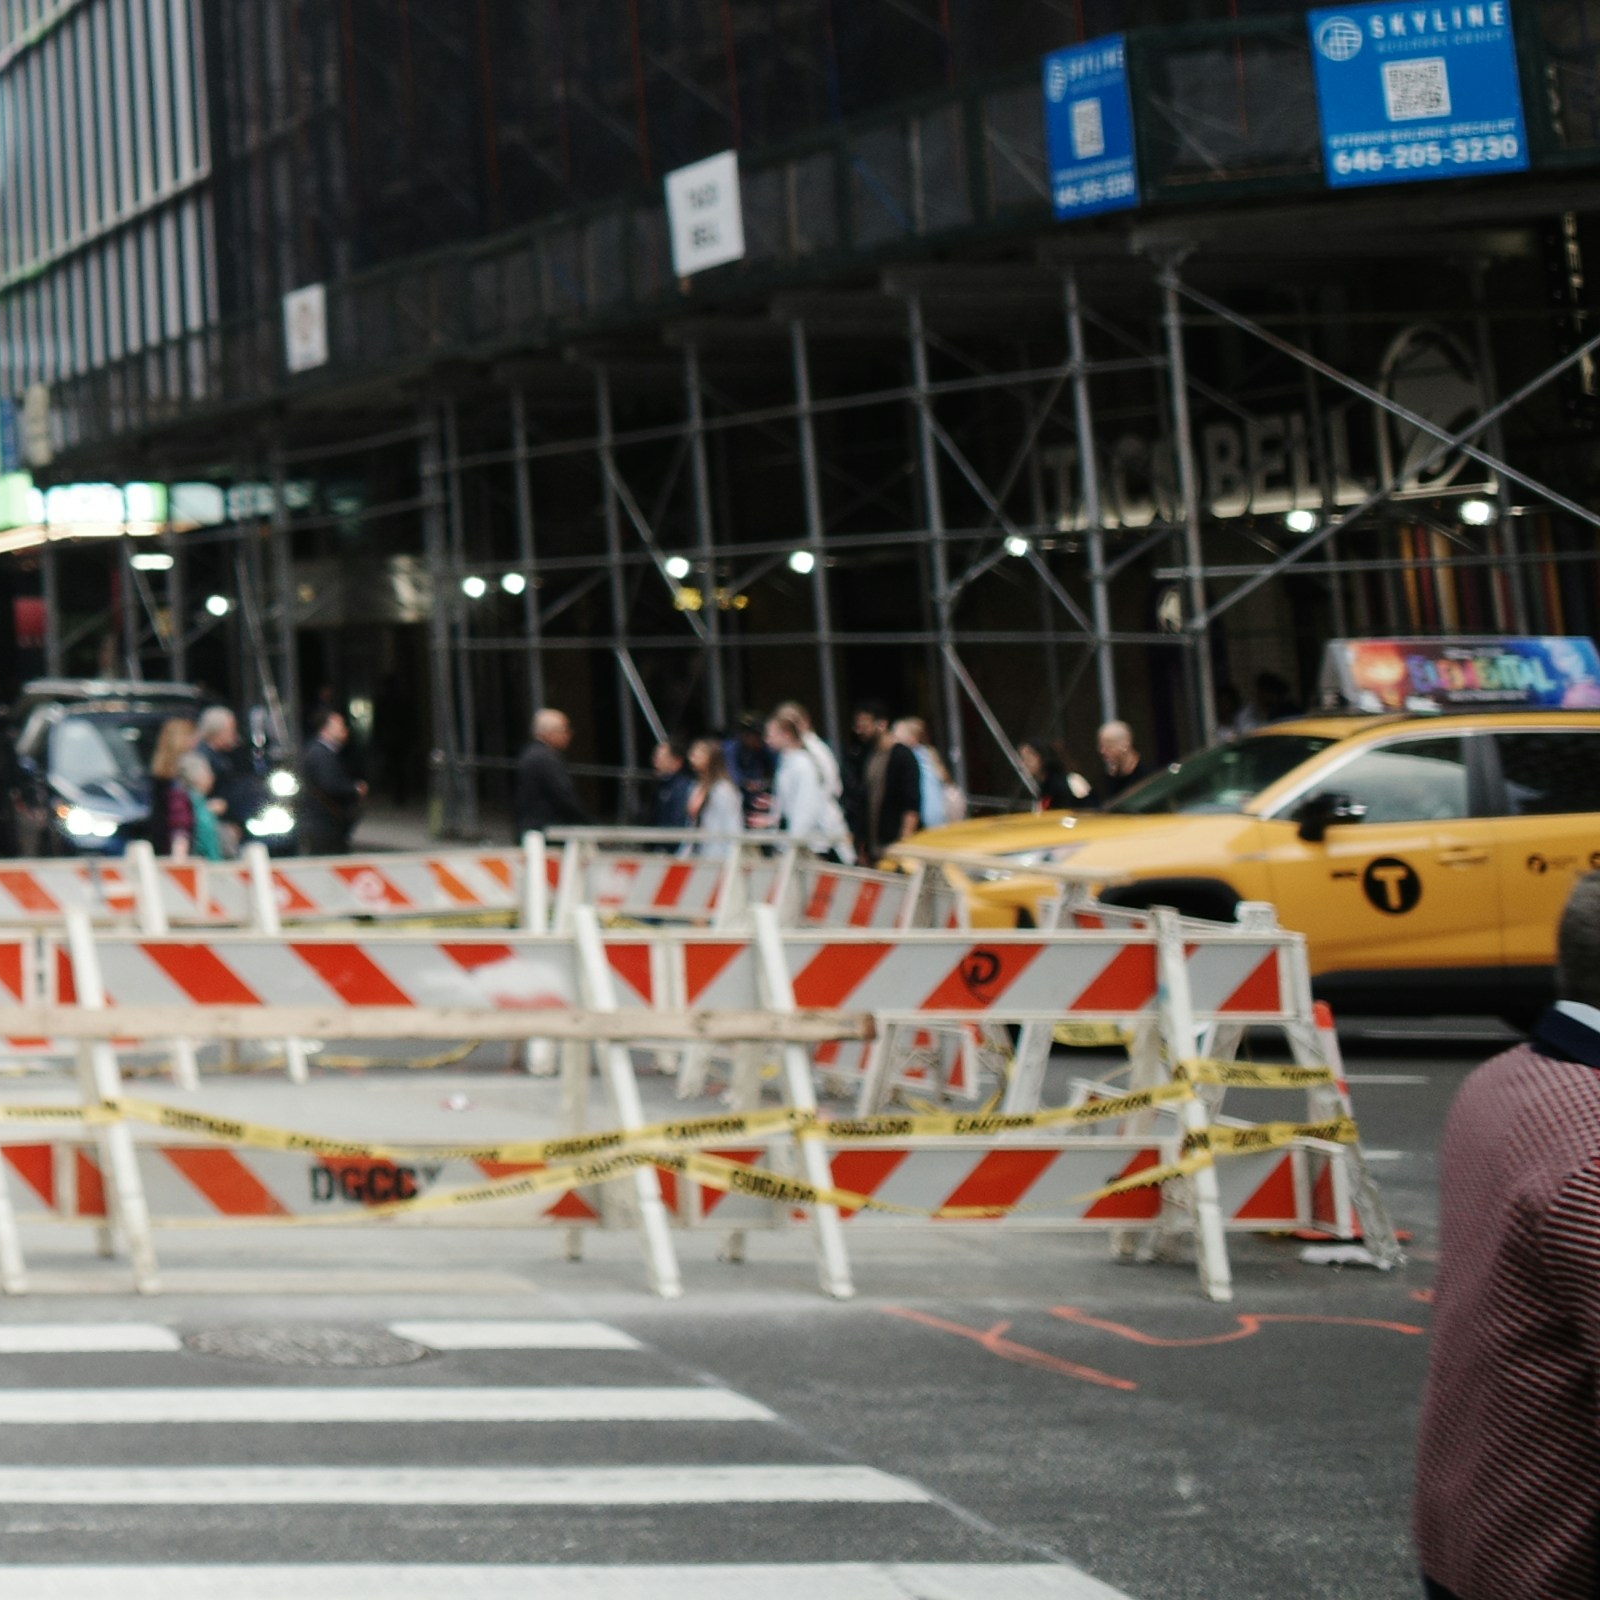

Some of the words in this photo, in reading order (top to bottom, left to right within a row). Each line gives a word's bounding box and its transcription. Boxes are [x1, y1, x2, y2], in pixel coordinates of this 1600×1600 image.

[1368, 1, 1506, 40] SKYLINE
[1334, 133, 1519, 175] 646-205-3230
[1203, 407, 1370, 519] BELL
